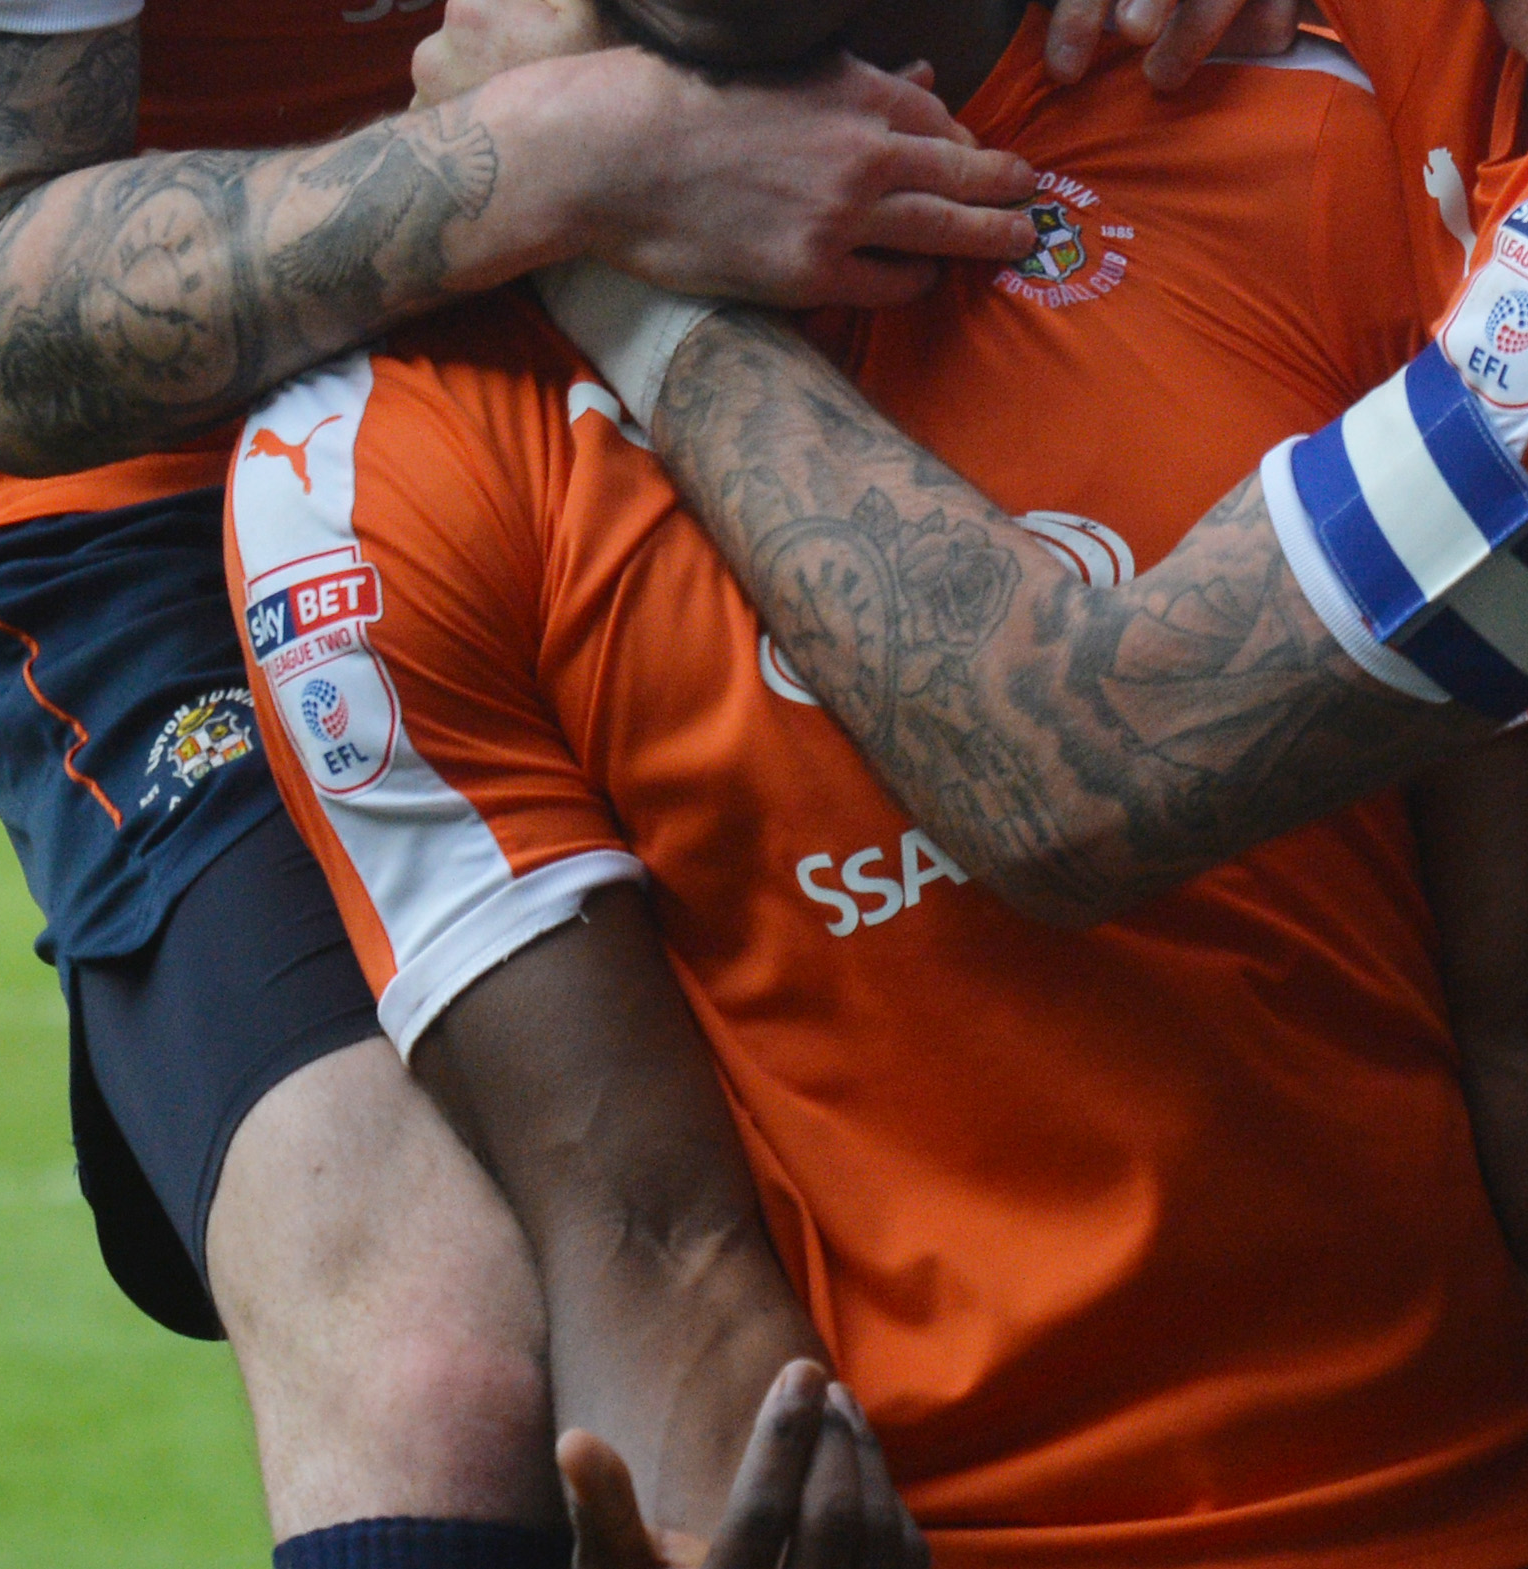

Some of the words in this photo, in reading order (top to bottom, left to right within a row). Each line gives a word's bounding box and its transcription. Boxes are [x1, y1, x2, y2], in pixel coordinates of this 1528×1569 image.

[1034, 171, 1099, 209] OWN
[993, 271, 1100, 309] FOOTBALL
[1467, 346, 1509, 391] EFL
[297, 576, 367, 624] BET
[313, 628, 353, 657] TWO
[323, 743, 369, 776] EFL
